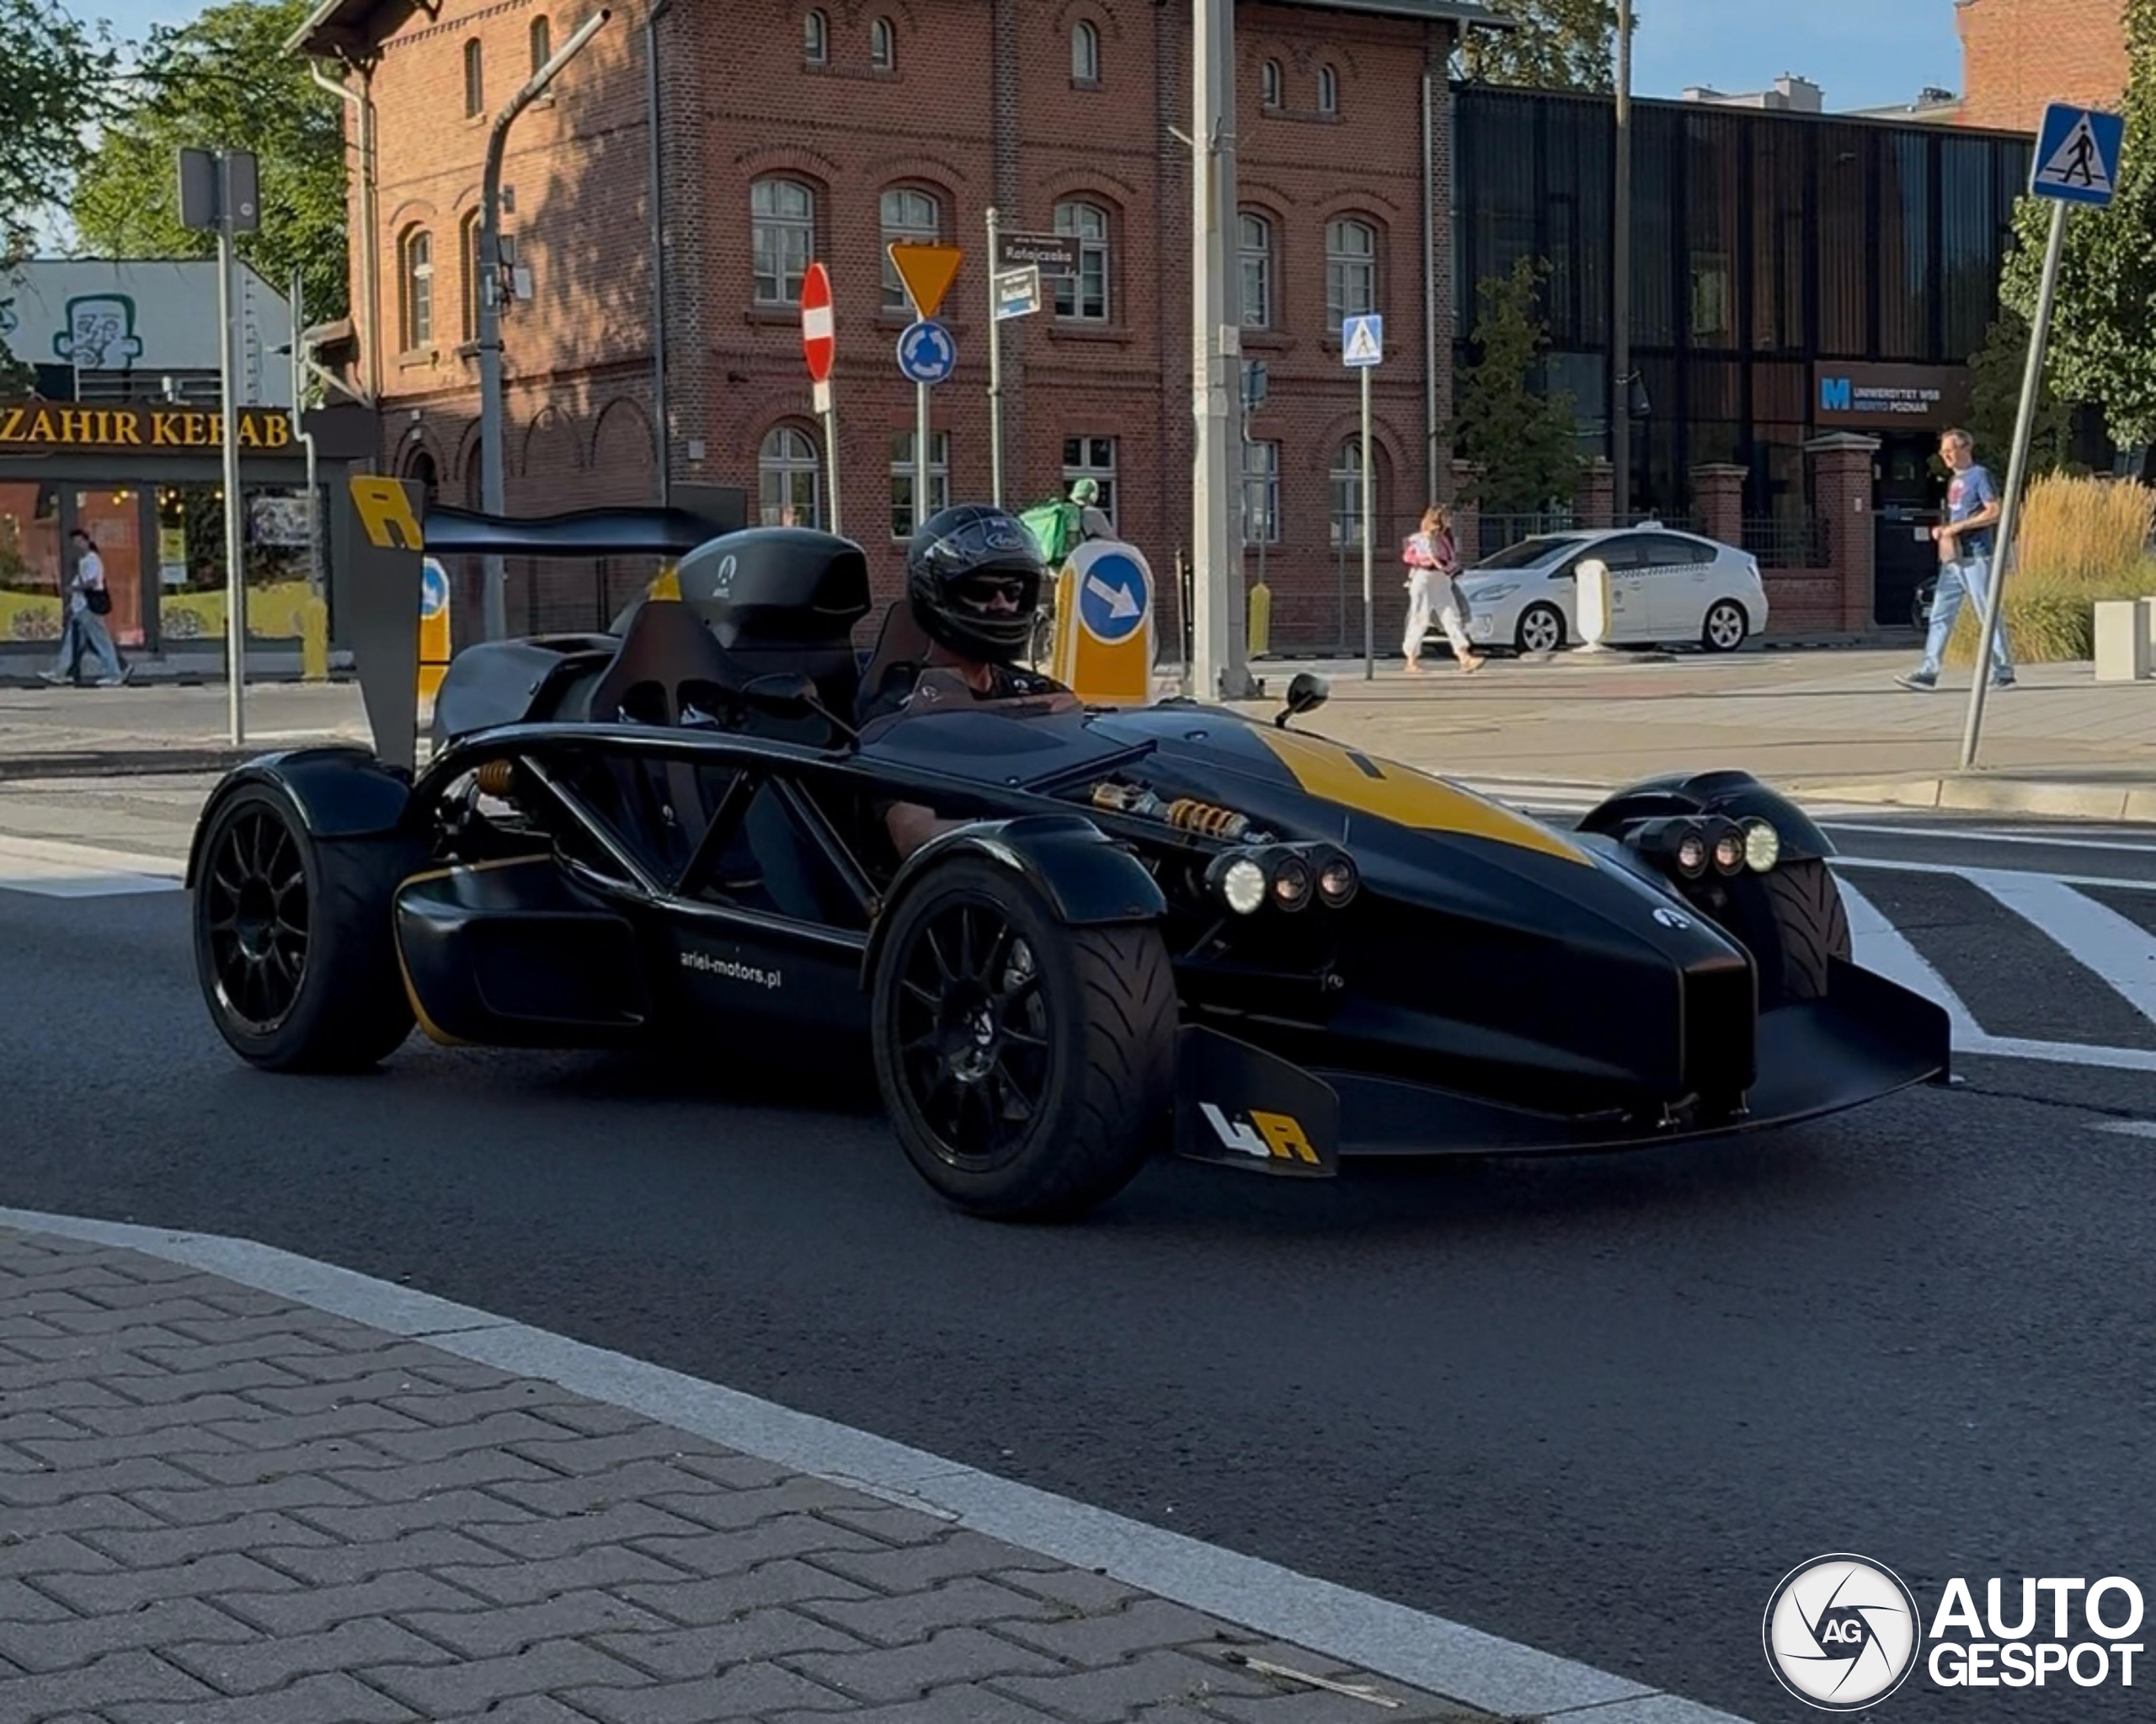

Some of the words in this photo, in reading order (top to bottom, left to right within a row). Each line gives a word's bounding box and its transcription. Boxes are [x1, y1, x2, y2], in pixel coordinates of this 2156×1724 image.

[0, 408, 141, 445] ZAHIR
[350, 475, 424, 552] R
[680, 951, 782, 990] ariel-motors.pl
